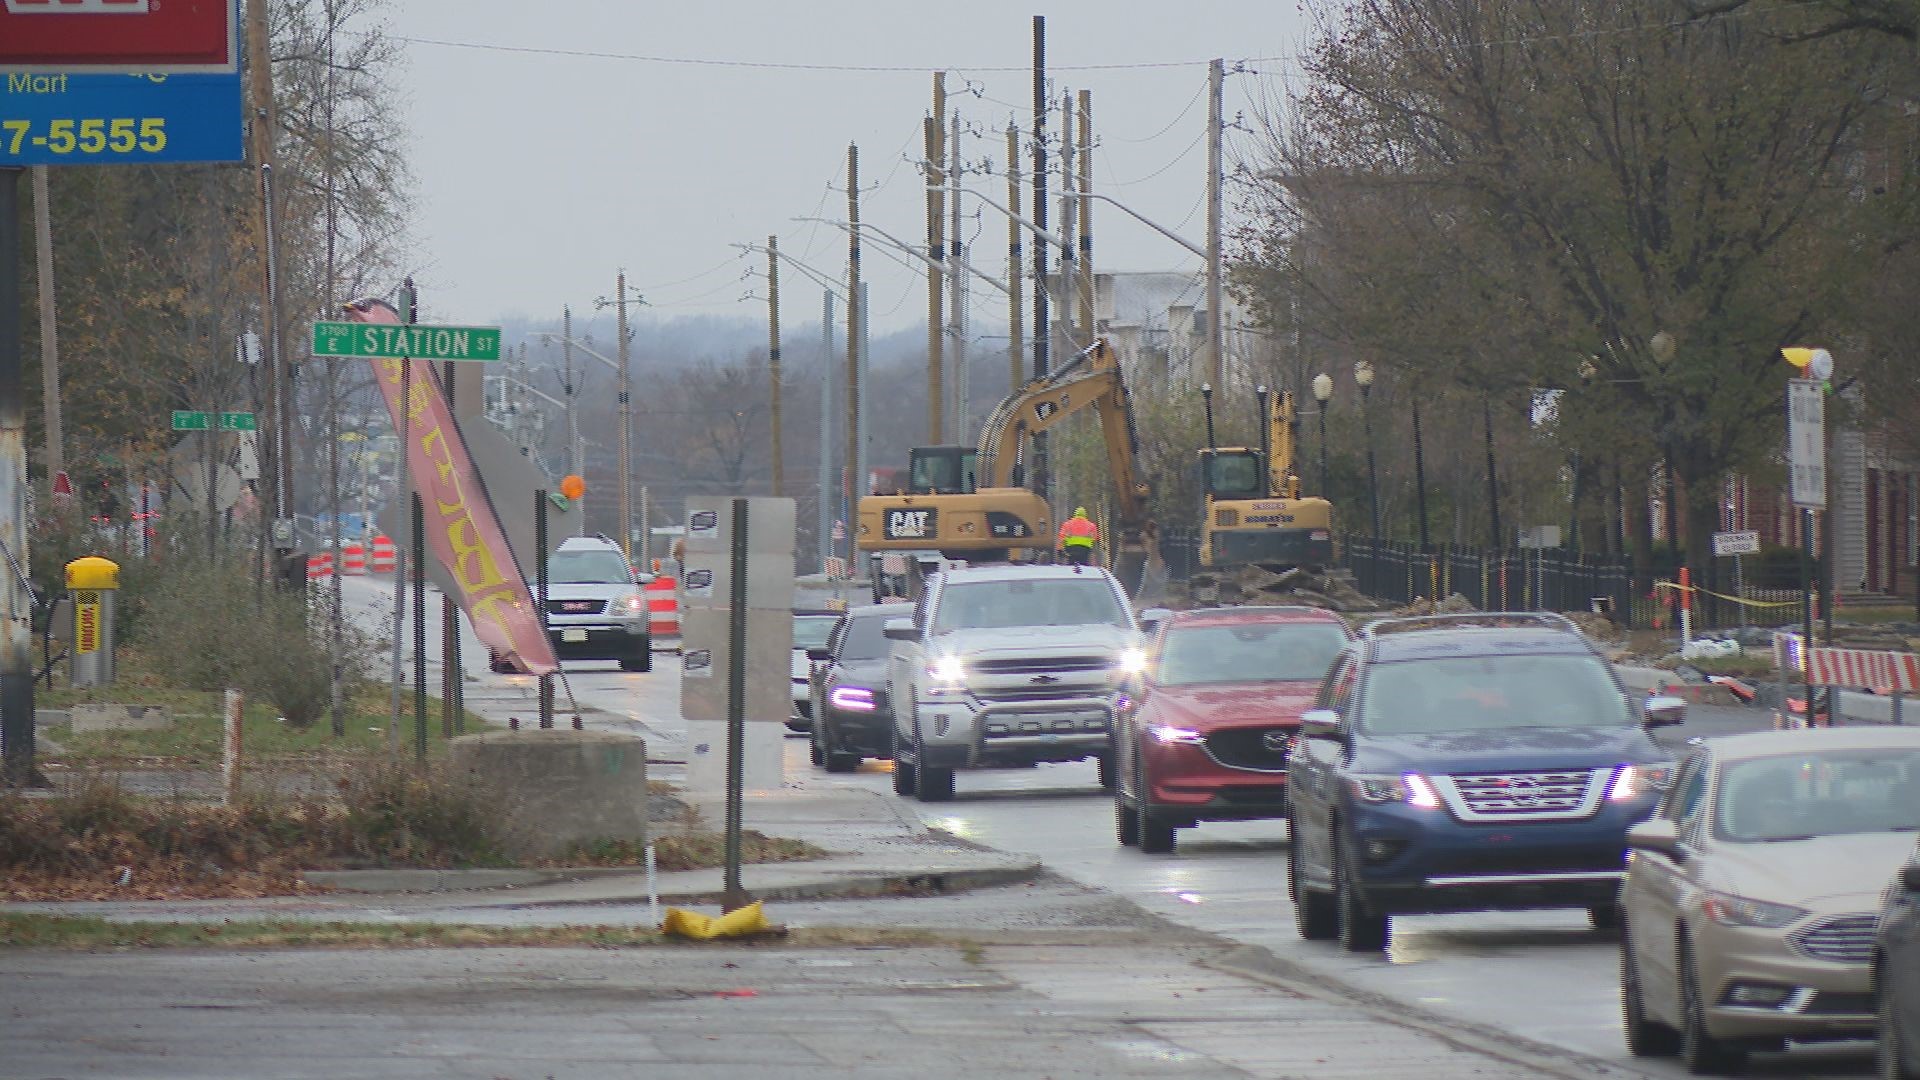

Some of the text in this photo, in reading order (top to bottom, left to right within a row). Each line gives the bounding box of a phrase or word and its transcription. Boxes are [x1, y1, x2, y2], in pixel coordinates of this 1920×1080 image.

[8, 73, 67, 93] Mart
[0, 118, 168, 154] 7-5555
[328, 327, 494, 356] E STATION ST
[889, 511, 930, 537] CAT
[1244, 514, 1295, 523] KOMATSU
[1716, 533, 1755, 543] SIDEWALK
[1721, 543, 1752, 552] CLOSED
[78, 591, 98, 604] AIR
[561, 601, 590, 610] GMC
